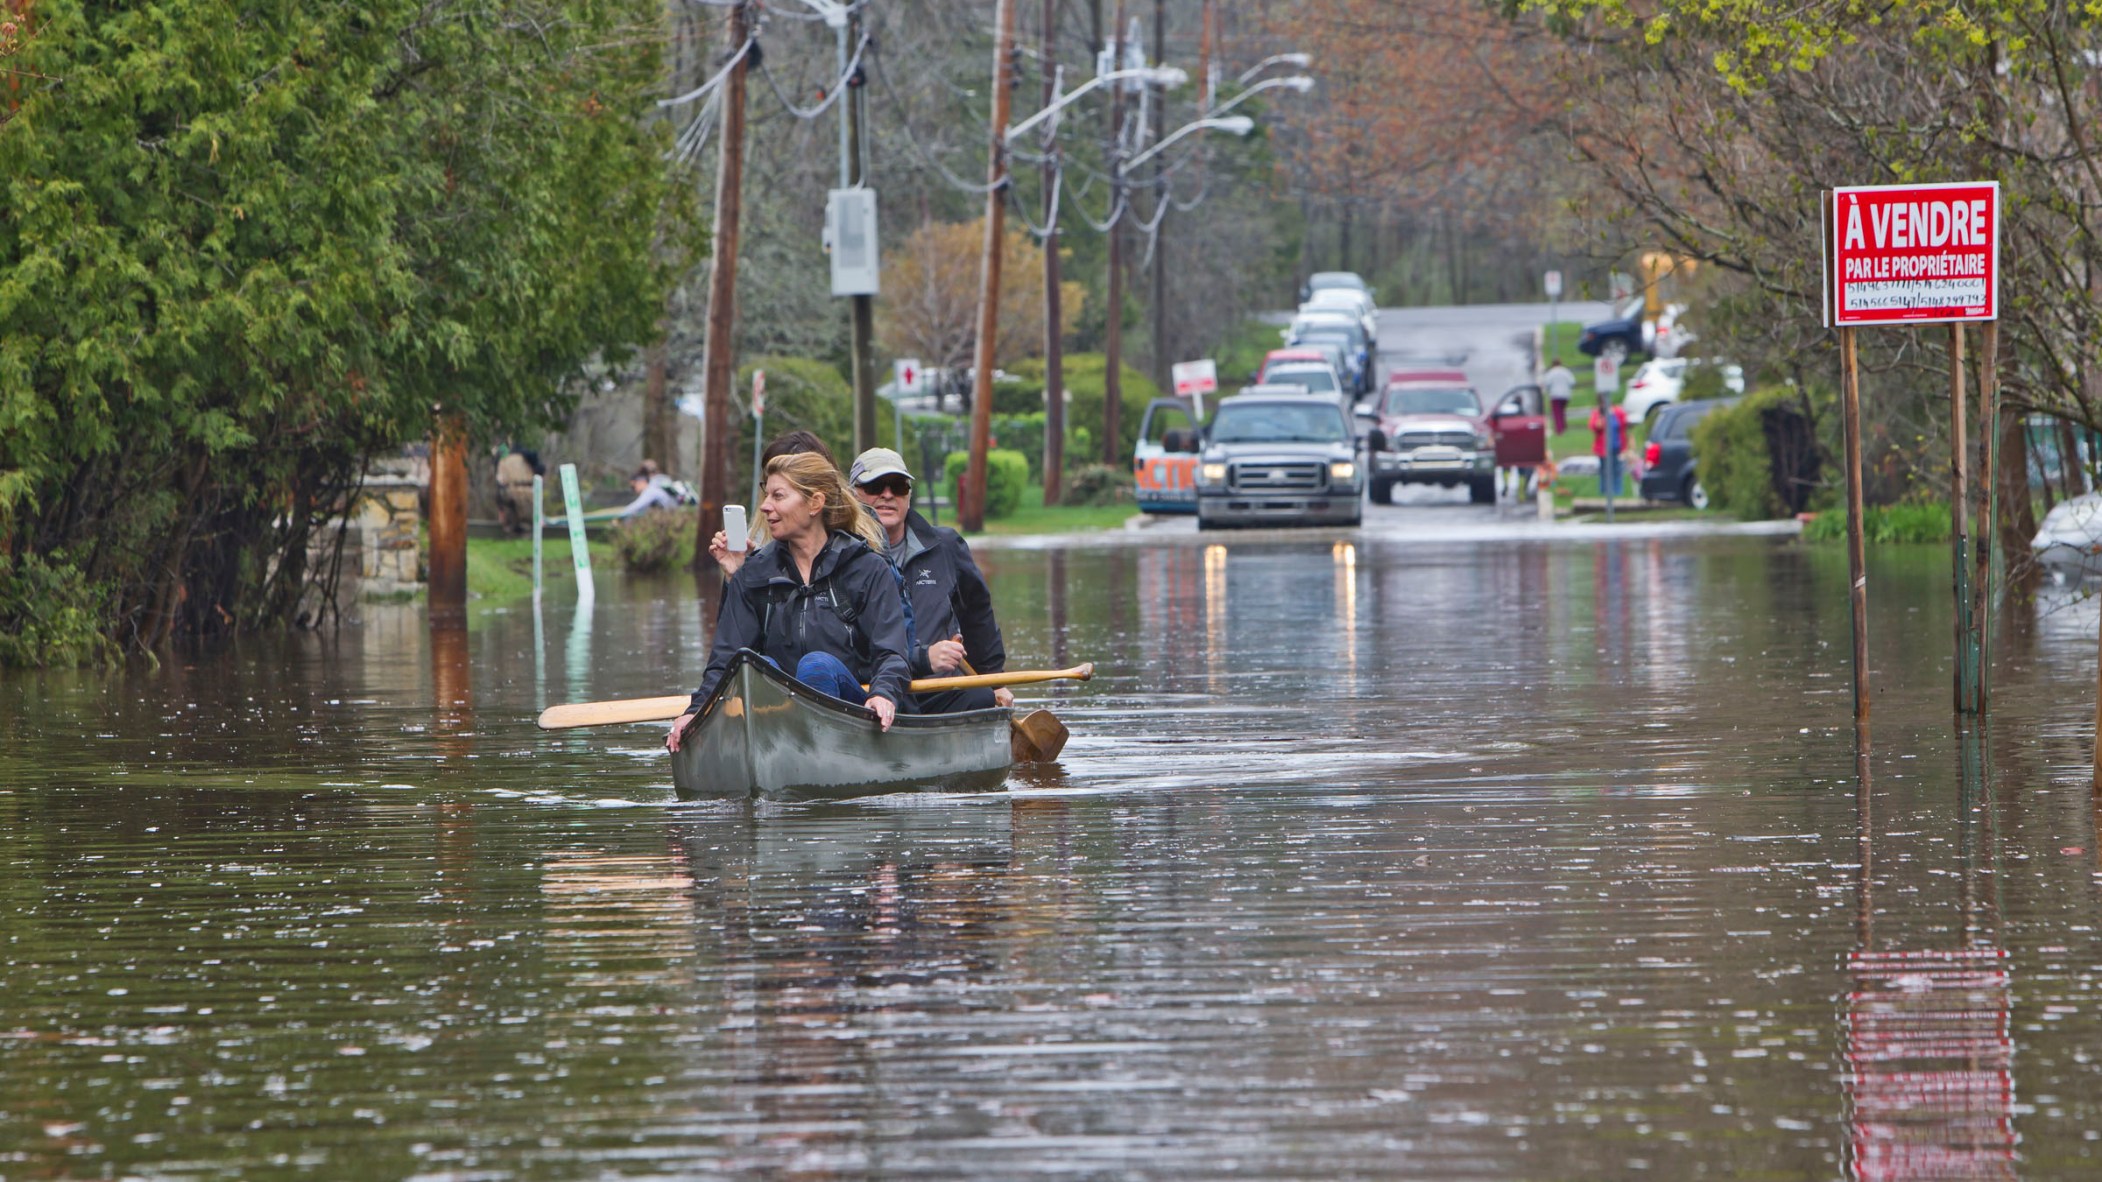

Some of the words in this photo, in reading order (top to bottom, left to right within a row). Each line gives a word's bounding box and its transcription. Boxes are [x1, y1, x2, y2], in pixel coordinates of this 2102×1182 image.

[1845, 194, 1866, 249] À
[1870, 200, 1986, 248] VENDRE
[1846, 257, 1872, 279] PAR
[1874, 257, 1890, 278] LE
[1892, 250, 1985, 277] PROPRIÉTAIRE
